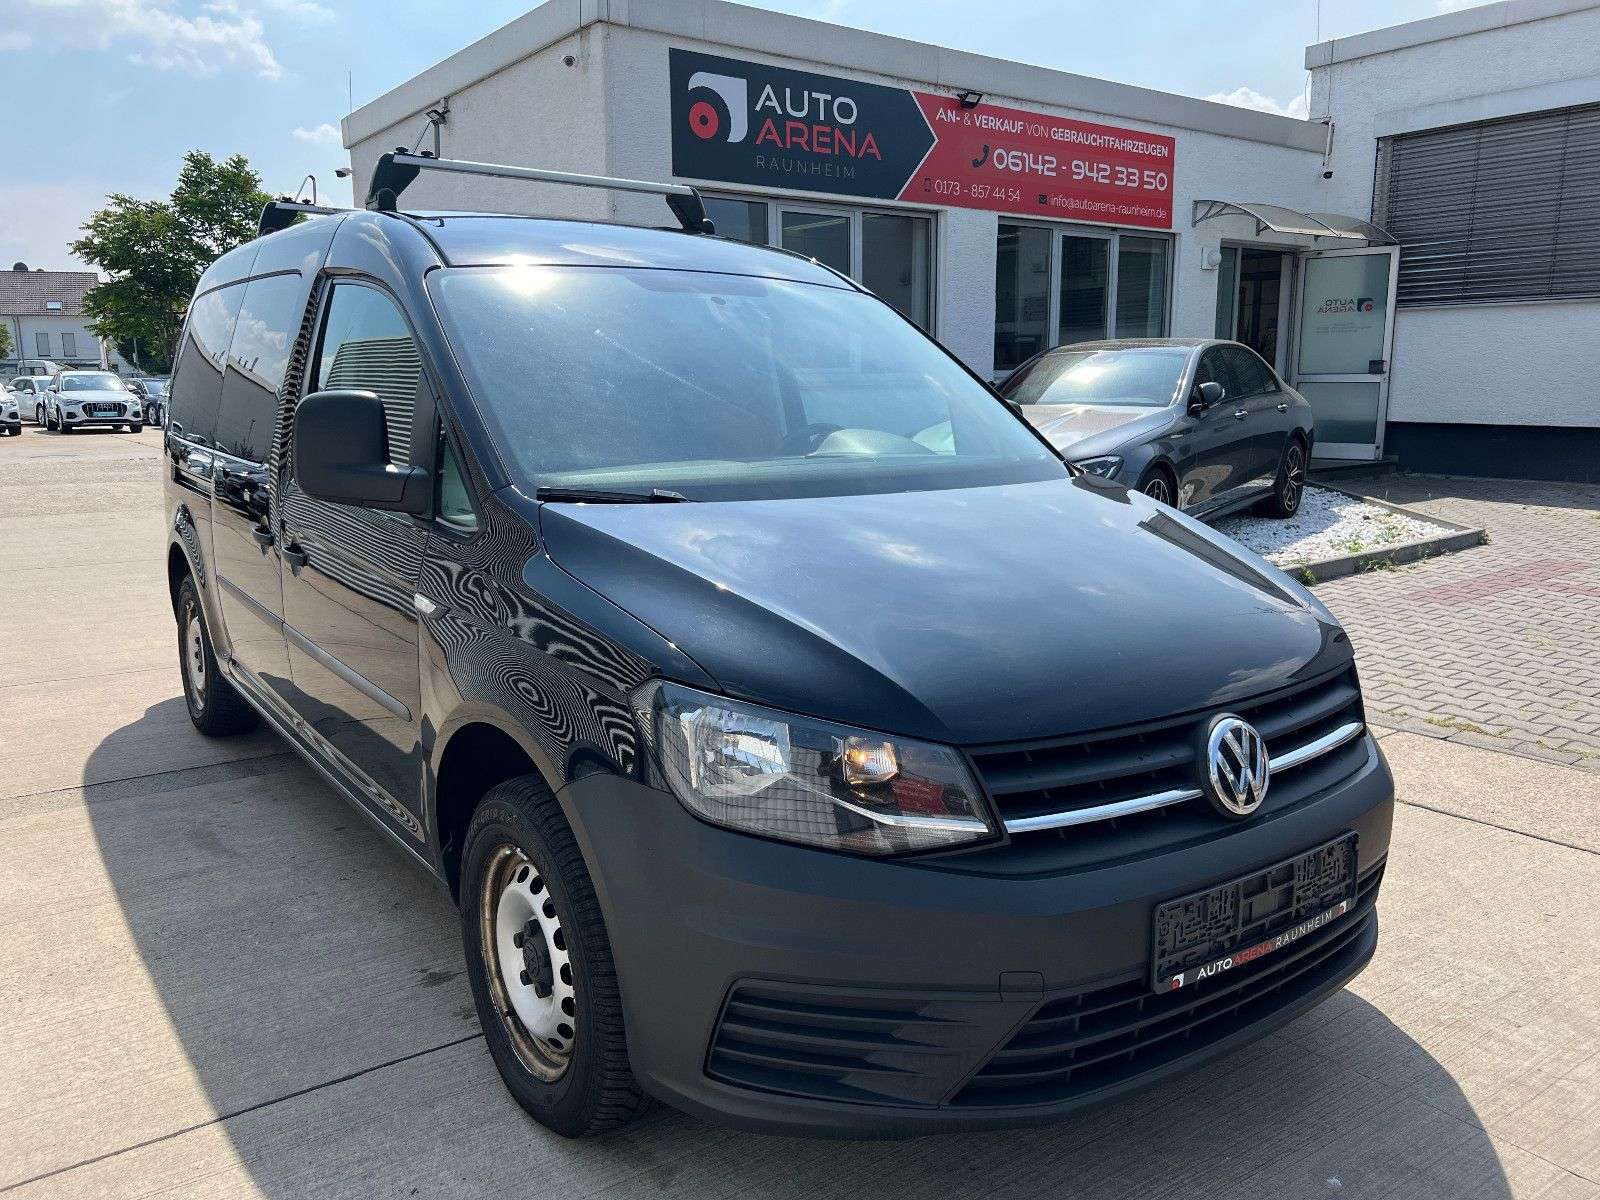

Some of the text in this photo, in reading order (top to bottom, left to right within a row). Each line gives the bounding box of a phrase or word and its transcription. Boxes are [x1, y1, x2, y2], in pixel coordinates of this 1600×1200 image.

[755, 84, 858, 124] AUTO
[755, 118, 882, 161] ARENA
[936, 107, 1168, 157] AN- & VERKAUF VON GEBRAUCHTFAHRZEUGEN
[756, 155, 856, 179] RAUNHEIM
[993, 148, 1057, 177] 06142
[1072, 159, 1110, 184] 942
[1114, 166, 1139, 188] 33
[1144, 170, 1168, 192] 50
[934, 179, 961, 196] 0173
[971, 184, 990, 199] 857
[992, 187, 1007, 200] 44
[1008, 189, 1021, 202] 54
[1051, 195, 1167, 219] info@autoarena-raunheim.de
[1275, 910, 1332, 949] RAUNHEIM
